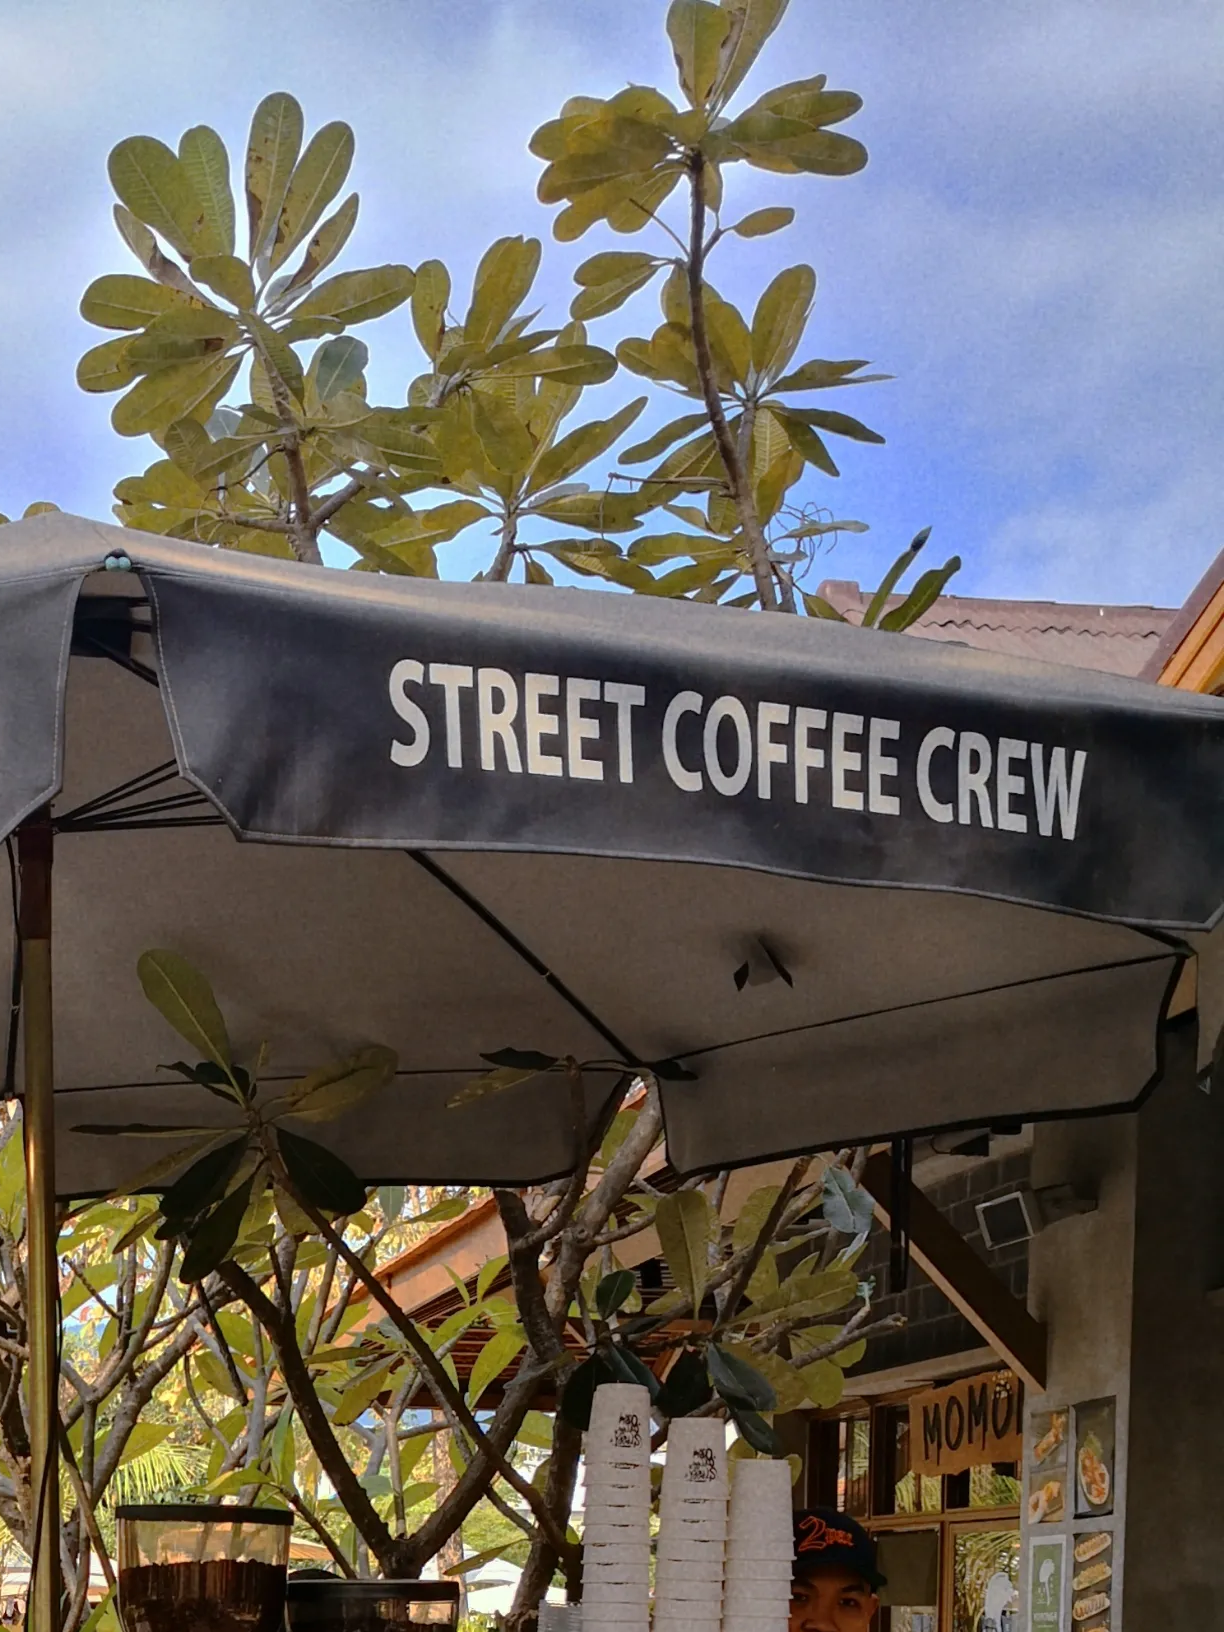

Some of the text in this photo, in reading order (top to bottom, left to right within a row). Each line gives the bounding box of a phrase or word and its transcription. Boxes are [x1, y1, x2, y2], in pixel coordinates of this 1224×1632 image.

[388, 658, 1088, 841] STREET COFFEE CREW
